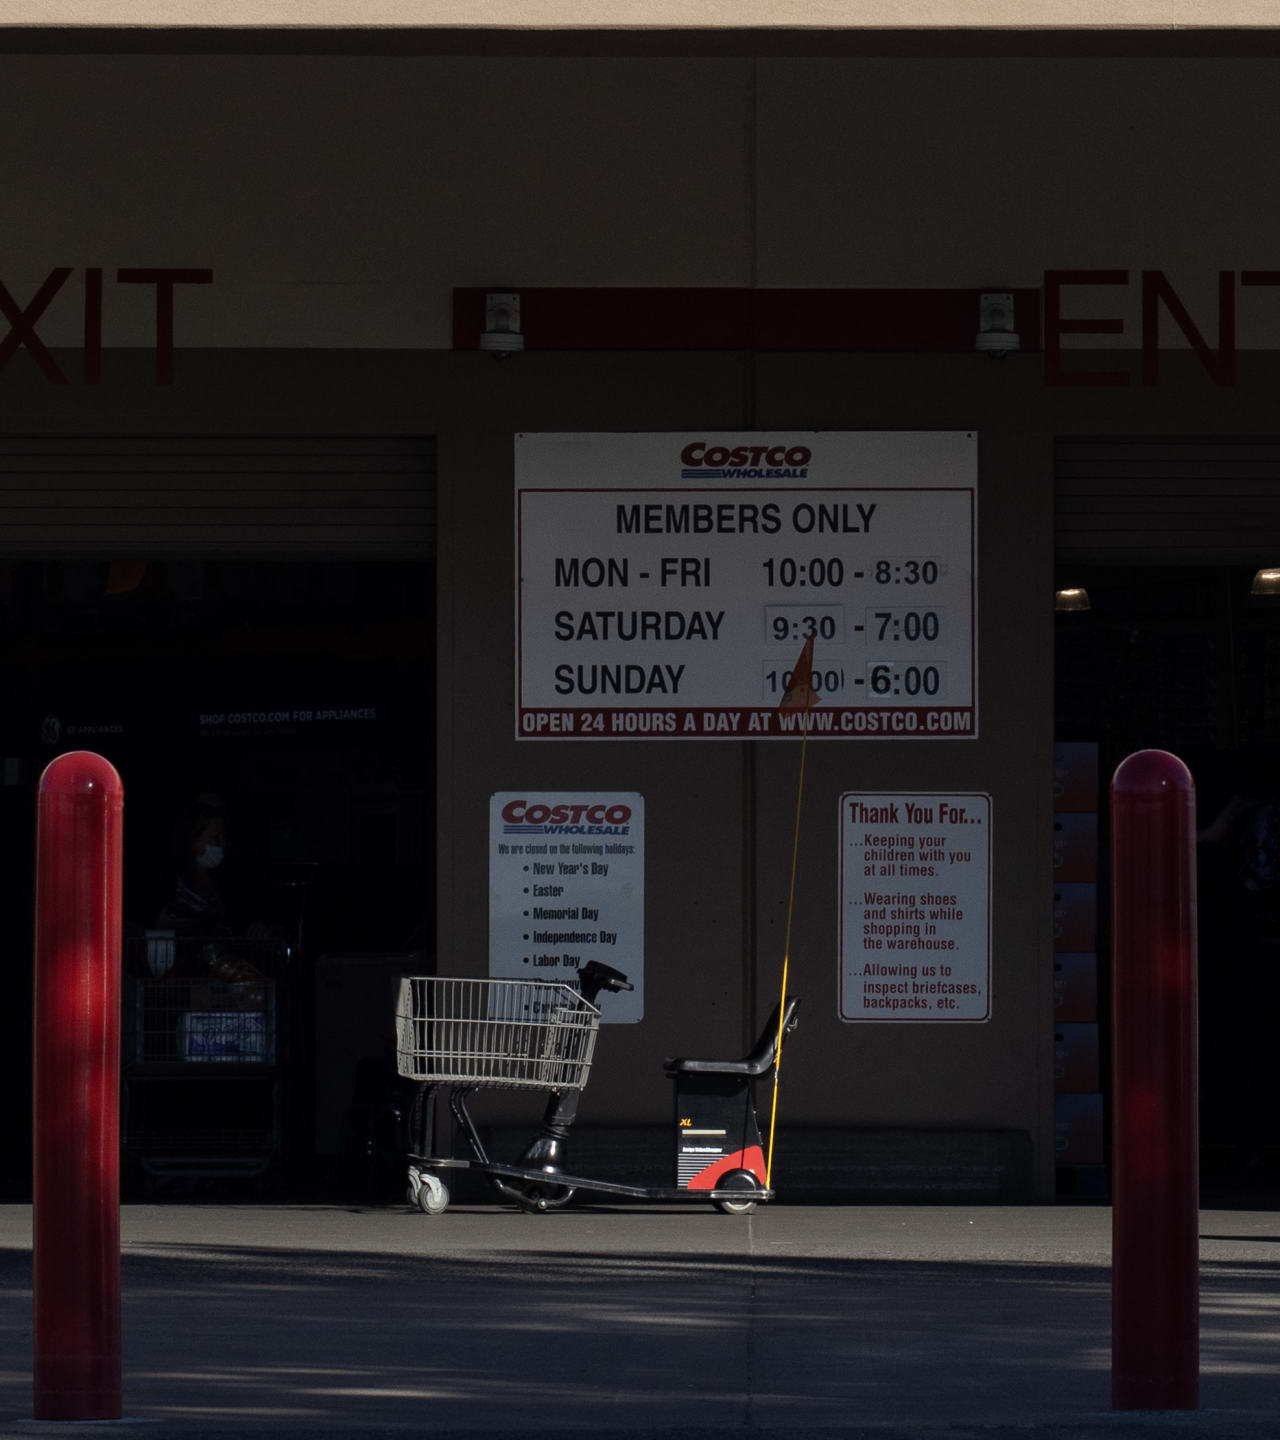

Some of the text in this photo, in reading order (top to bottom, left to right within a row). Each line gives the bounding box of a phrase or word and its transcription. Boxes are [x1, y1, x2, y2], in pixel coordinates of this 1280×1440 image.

[681, 442, 812, 467] COSTCO
[722, 469, 808, 478] WHOLESALE
[617, 503, 877, 533] MEMBERS ONLY
[555, 558, 628, 587] MON
[661, 558, 711, 587] FRI
[763, 558, 844, 586] 10:00
[875, 561, 938, 584] 8:30
[555, 611, 725, 641] SATURDAY
[773, 616, 836, 641] 9:30
[875, 612, 939, 641] 7:00
[555, 664, 686, 694] SUNDAY
[871, 665, 940, 695] 6:00
[199, 708, 376, 725] SHOP COSTCO.COM FOR APPLIANCES
[522, 712, 971, 732] OPEN 24 HOURS A DAY AT WWW.COSTCO.COM
[502, 800, 632, 824] COSTCO
[849, 802, 982, 824] Thank You For...
[544, 825, 630, 835] WHOLESALE
[919, 836, 946, 849] your
[499, 844, 510, 854] We
[511, 845, 523, 854] are
[525, 844, 547, 854] closed
[549, 846, 558, 854] on
[560, 844, 570, 854] the
[572, 844, 603, 856] following
[864, 849, 971, 864] children with you
[533, 862, 609, 877] New Year's Day
[864, 864, 939, 876] at all times.
[533, 884, 564, 897] Easter
[920, 893, 957, 905] shoes
[533, 907, 599, 921] Memorial Day
[863, 908, 963, 920] and shirts while
[863, 922, 936, 937] shopping in
[533, 931, 617, 945] Independence Day
[863, 937, 959, 950] the warehouse.
[533, 954, 580, 968] Labor Day
[922, 966, 936, 976] us
[940, 964, 952, 976] to
[863, 981, 981, 995] inspect briefcases,
[863, 996, 960, 1010] backpacks, etc.
[680, 1118, 692, 1126] XL
